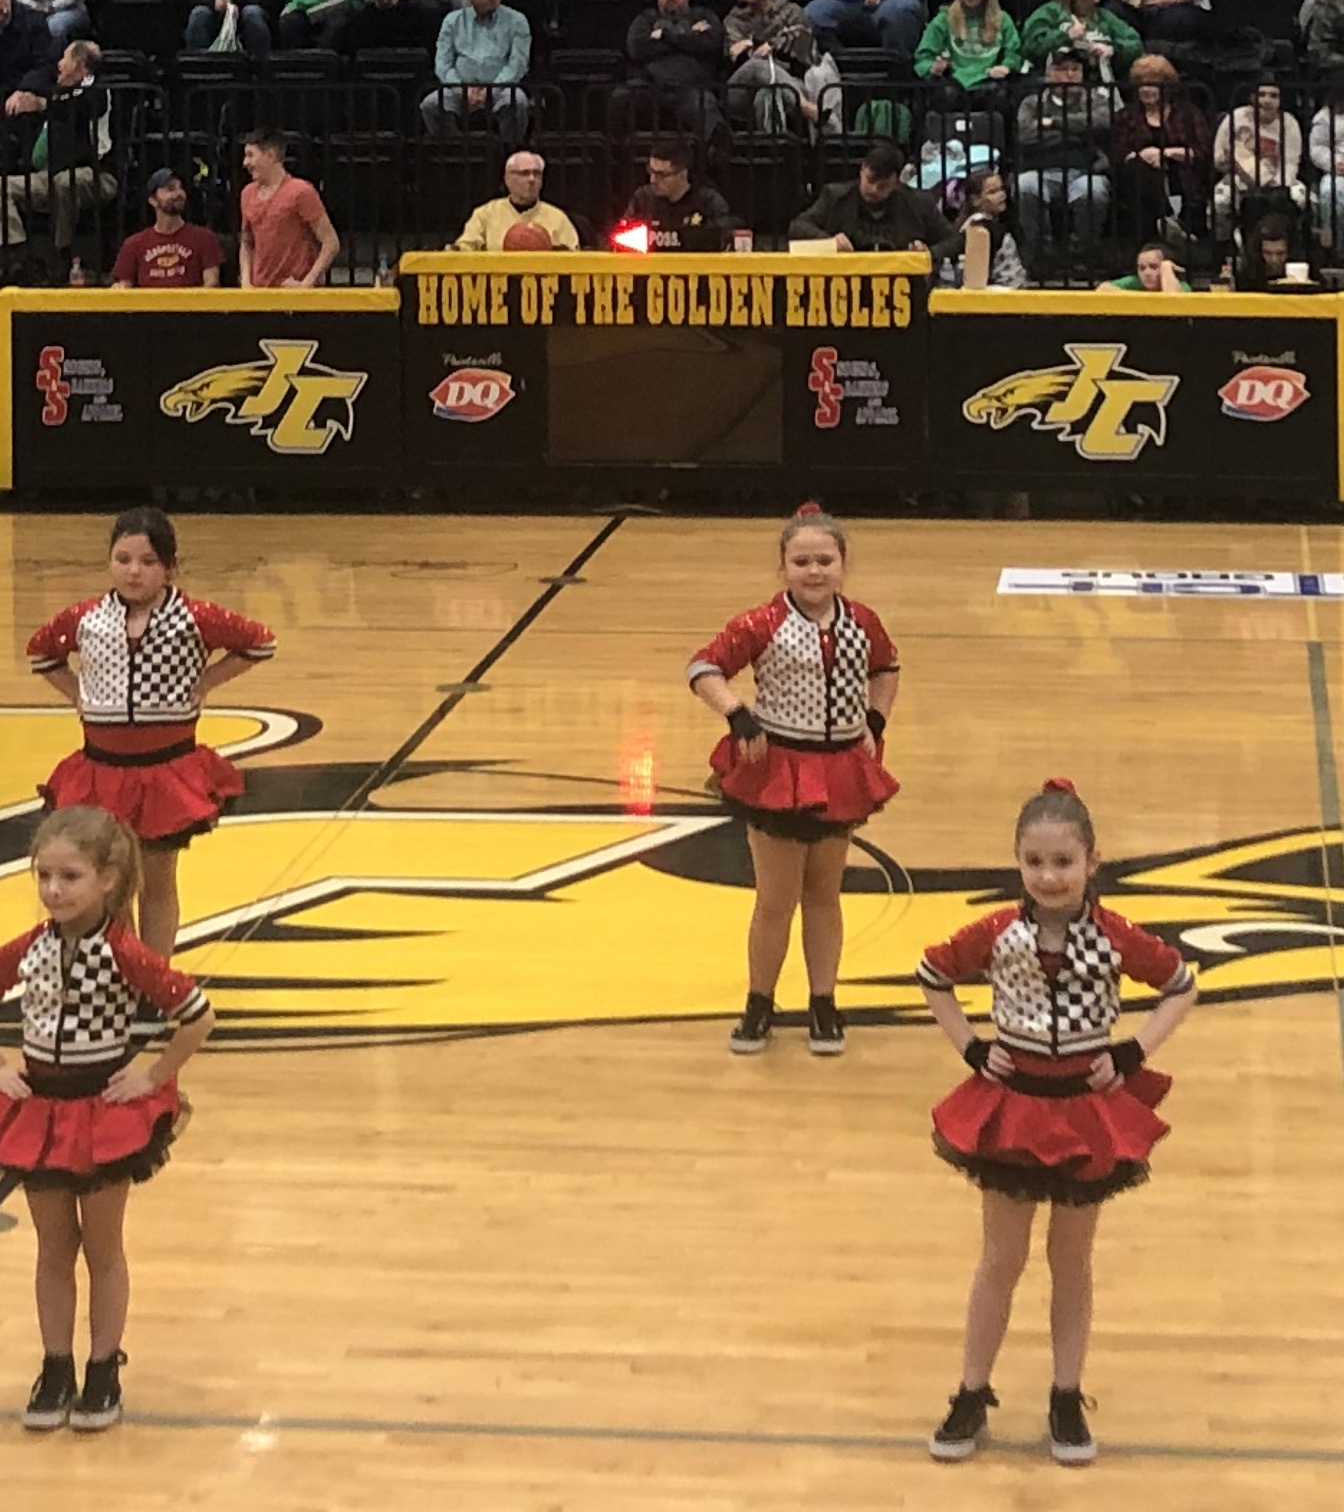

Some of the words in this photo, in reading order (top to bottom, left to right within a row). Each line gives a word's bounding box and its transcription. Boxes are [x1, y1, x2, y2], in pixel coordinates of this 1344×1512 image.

[418, 274, 509, 325] HOME
[520, 274, 559, 325] OF
[570, 274, 635, 326] THE
[647, 275, 774, 327] GOLDEN
[786, 276, 911, 328] EAGLES
[445, 381, 500, 408] DQ
[1236, 379, 1294, 409] DQ
